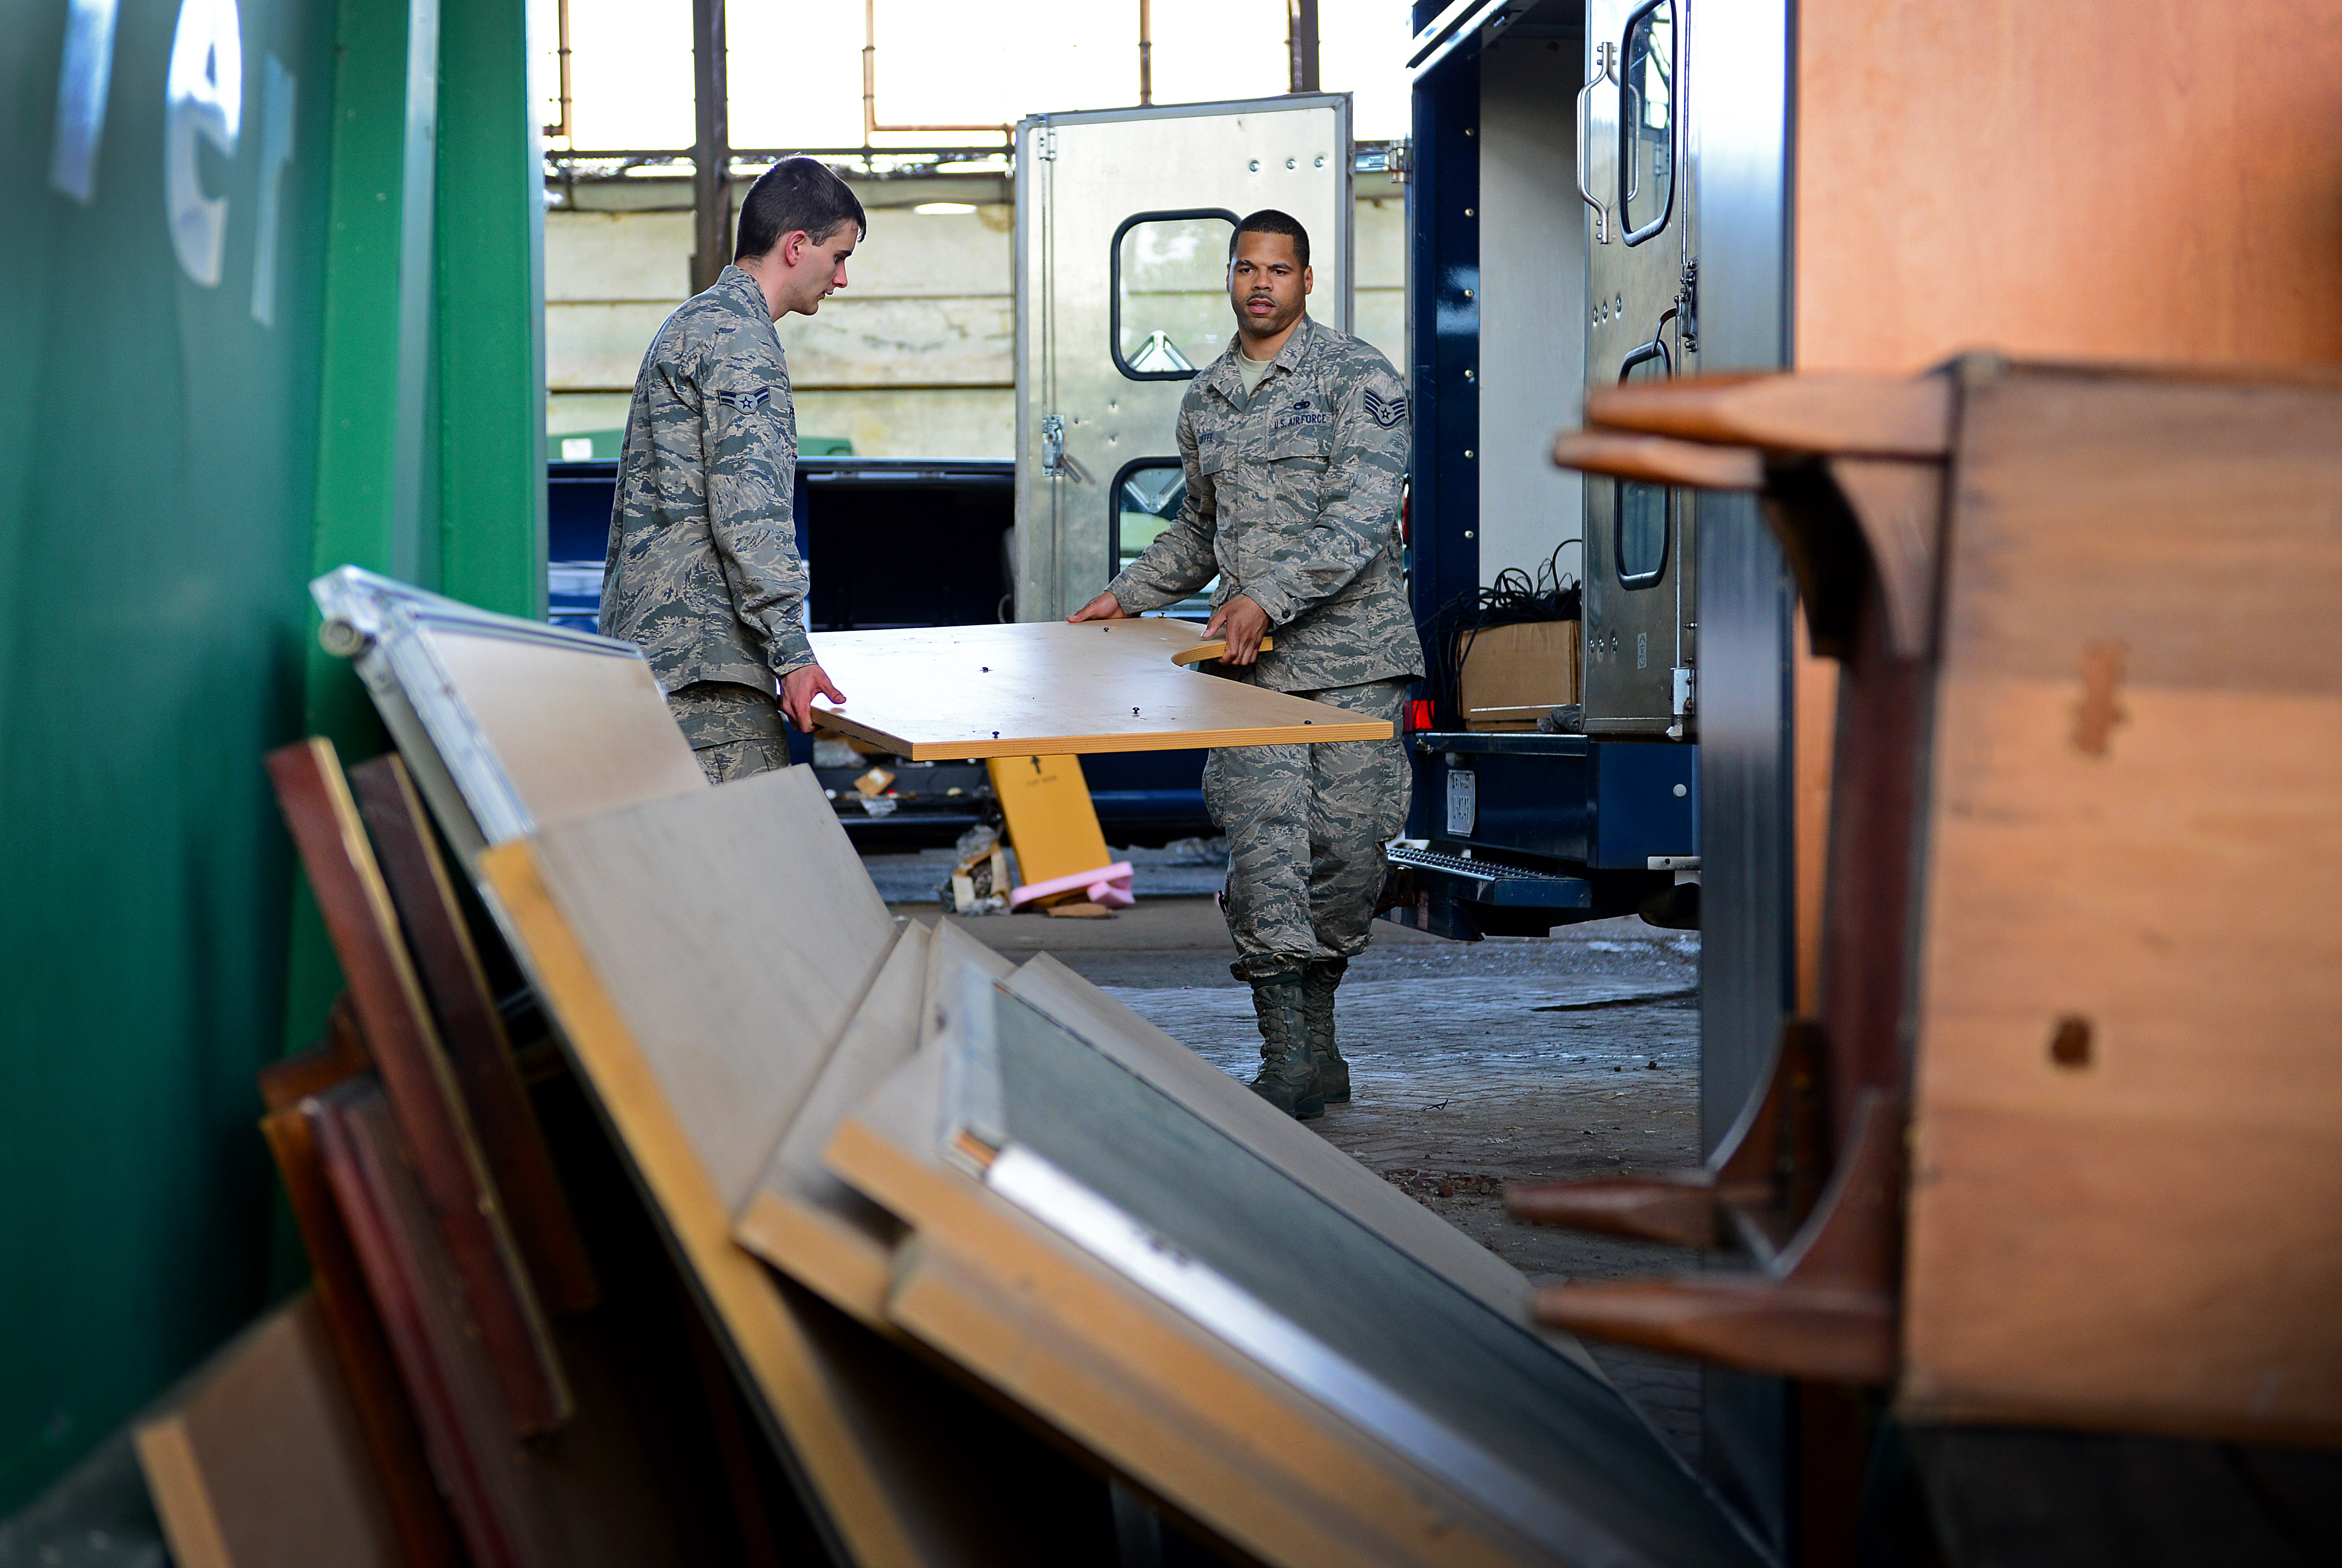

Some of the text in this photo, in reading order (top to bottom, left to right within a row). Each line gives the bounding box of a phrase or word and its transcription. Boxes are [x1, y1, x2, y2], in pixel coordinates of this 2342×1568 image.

[1274, 414, 1326, 429] U.S. AIR FORCE
